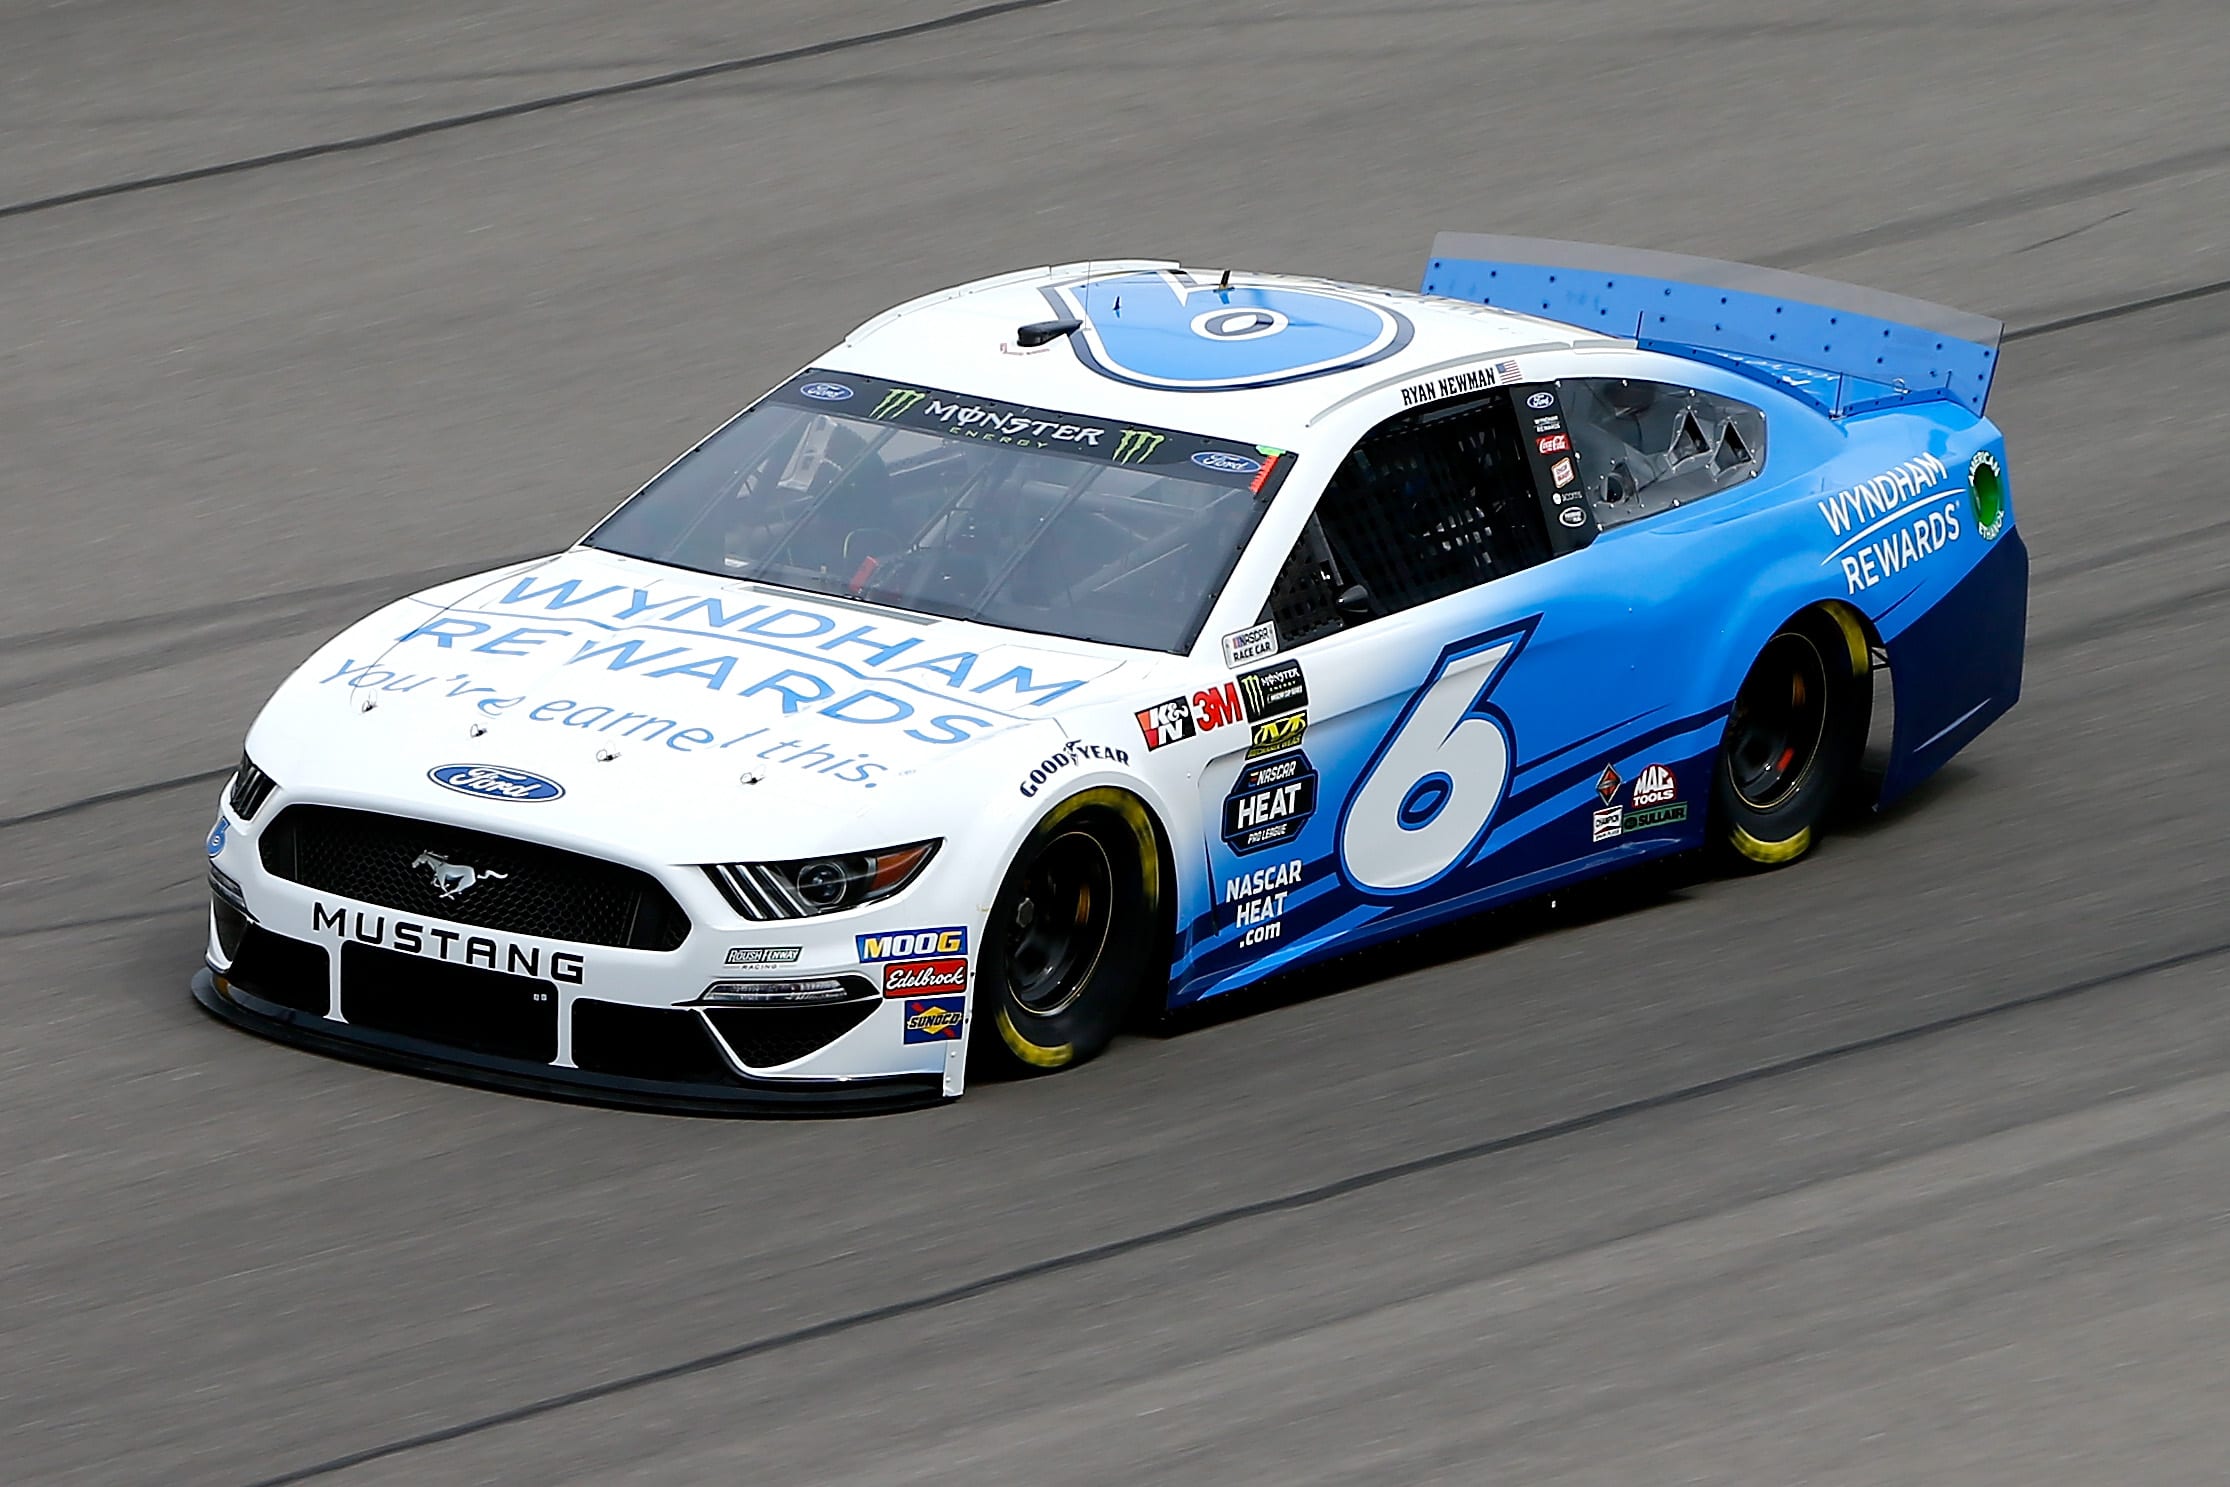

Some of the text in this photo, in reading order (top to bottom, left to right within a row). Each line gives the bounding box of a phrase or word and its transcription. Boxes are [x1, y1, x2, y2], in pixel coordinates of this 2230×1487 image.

[806, 383, 845, 399] Ford
[1401, 367, 1496, 406] RYAN NEWMAN
[949, 426, 1048, 449] ENERGY
[1202, 453, 1249, 472] Ford
[1968, 450, 2001, 487] AMERICAN
[1818, 452, 1948, 536] WYNDHAM
[1841, 503, 1960, 595] REWARDS
[499, 577, 1089, 707] WYNDHAM
[1233, 641, 1272, 661] RACE CAR
[399, 617, 992, 745] REWARDS
[1193, 682, 1243, 732] 3M
[758, 738, 887, 789] this.
[1019, 739, 1130, 798] GOODYEAR
[1256, 761, 1297, 786] NASCAR
[1336, 620, 1538, 894] 6
[447, 766, 542, 798] Ford
[1633, 765, 1675, 796] MAC
[1237, 782, 1302, 829] HEAT
[1633, 789, 1674, 807] TOOLS
[1638, 807, 1686, 827] SULLAIR
[1226, 860, 1302, 903] NASCAR
[1236, 891, 1288, 929] HEAT
[313, 902, 584, 986] MUSTANG
[863, 931, 962, 959] MOOG
[1239, 922, 1281, 948] .com
[728, 949, 762, 963] ROUSH
[886, 966, 965, 990] Edelbrock
[908, 1012, 961, 1029] SUNOCO
